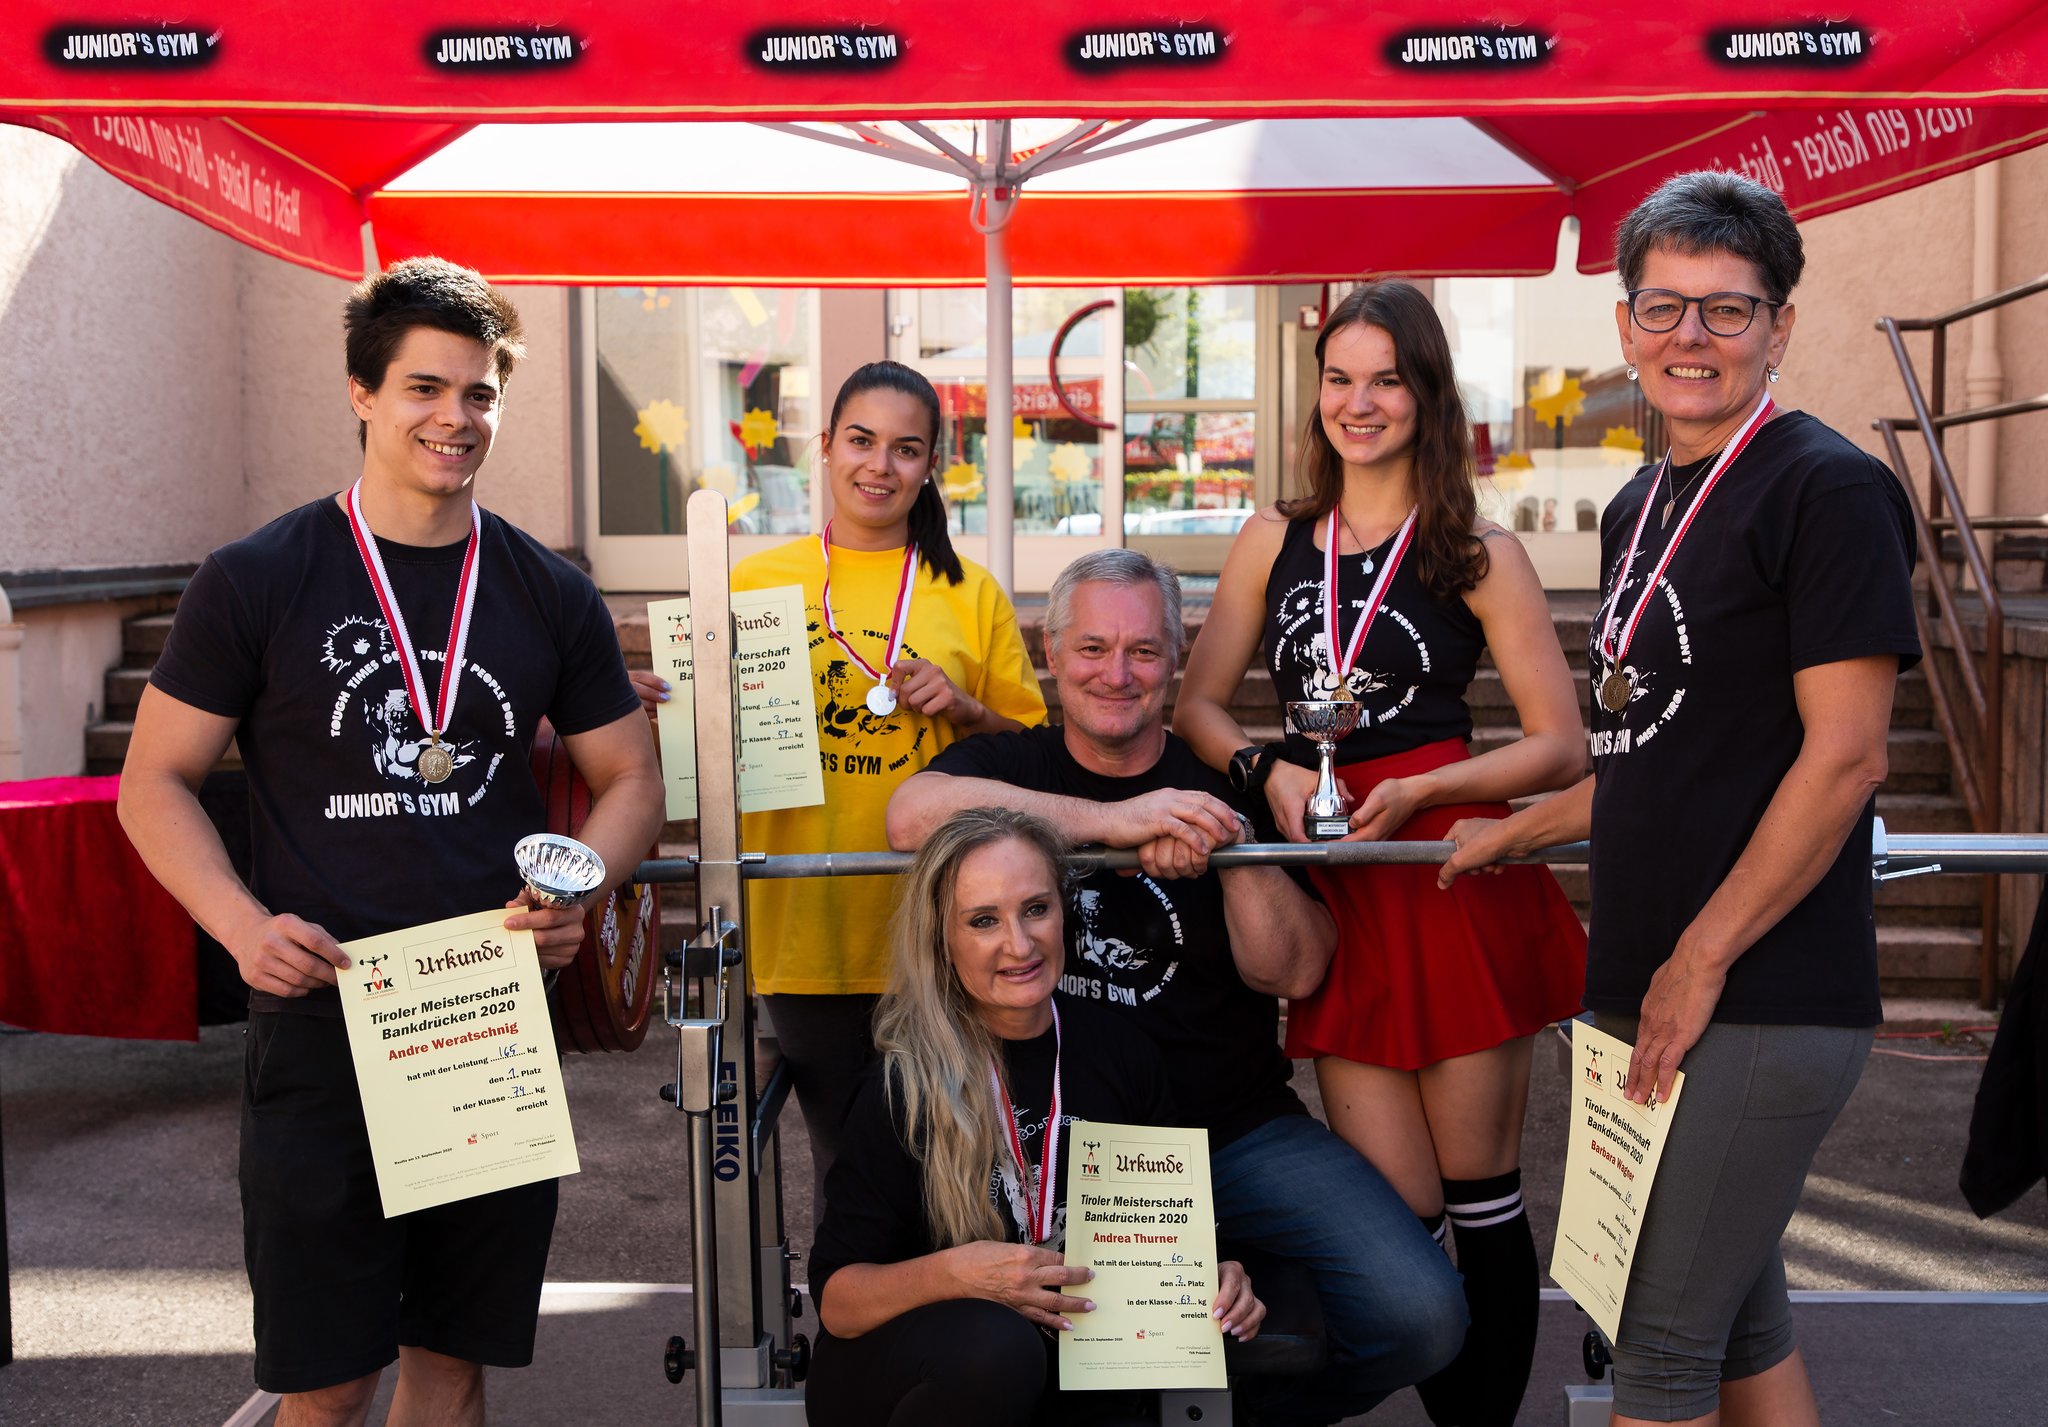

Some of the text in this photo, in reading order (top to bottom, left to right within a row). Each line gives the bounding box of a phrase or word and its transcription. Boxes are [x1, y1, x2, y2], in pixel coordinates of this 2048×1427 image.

[63, 32, 198, 60] JUNIOR'S GYM
[436, 35, 528, 63] JUNIOR'S
[530, 35, 572, 60] GYM
[762, 34, 853, 62] JUNIOR'S
[855, 34, 897, 59] GYM
[1080, 31, 1172, 59] JUNIOR'S
[1173, 31, 1216, 56] GYM
[1402, 35, 1493, 63] JUNIOR'S
[1495, 35, 1537, 60] GYM
[1726, 31, 1818, 59] JUNIOR'S
[1819, 31, 1862, 56] GYM
[736, 611, 781, 632] kunde
[1664, 584, 1692, 665] PEOPLE DON'T
[669, 633, 691, 643] TVK
[808, 636, 825, 651] MES
[862, 629, 890, 641] TOUG
[900, 643, 922, 659] PEO
[1274, 600, 1432, 673] TOUGH TIMES TOH PEOPLE DON'T
[672, 646, 791, 668] Tiro terschaft
[757, 661, 786, 673] 2020
[330, 690, 351, 738] TOUGH
[346, 659, 380, 690] TIMES
[420, 649, 468, 668] TOU
[469, 663, 506, 700] PEOPLE
[501, 701, 515, 738] DON'T
[742, 681, 764, 691] Sari
[740, 703, 761, 711] istung
[768, 697, 781, 707] 60
[1377, 706, 1400, 724] IMST
[759, 719, 771, 727] den
[784, 716, 802, 724] Platz
[1636, 687, 1686, 748] IMST TIROL
[749, 735, 771, 743] Klasse
[794, 731, 803, 739] kg
[778, 742, 804, 751] erreicht
[888, 726, 928, 771] IMST TIROL
[845, 755, 882, 775] GYM
[467, 752, 505, 807] IMST TIROL
[324, 791, 460, 820] JUNIOR'S GYM
[1143, 877, 1184, 945] PEOPLE DON'T
[414, 939, 505, 977] Urkunde
[363, 977, 394, 993] TVK
[1058, 973, 1138, 1007] IOR'S GYM
[1142, 984, 1162, 1002] IMST
[370, 1005, 418, 1025] Tiroler
[420, 981, 521, 1014] Meisterschaft
[381, 999, 516, 1041] Bankdrücken 2020
[387, 1021, 519, 1061] Andre Weratschnig
[406, 1042, 538, 1082] hat mit der Leistung 165 kg
[488, 1075, 505, 1085] den
[520, 1067, 542, 1077] Platz
[1585, 1067, 1603, 1084] TVK
[452, 1105, 462, 1113] in
[462, 1101, 477, 1111] der
[477, 1095, 506, 1107] Klasse
[534, 1085, 546, 1095] kg
[516, 1100, 549, 1113] erreicht
[714, 1062, 740, 1182] EEIKO
[1019, 1124, 1036, 1141] GO
[1584, 1097, 1651, 1151] Tiroler Meisterschaft
[480, 1130, 500, 1140] Sport
[1587, 1115, 1644, 1165] Bankdrücken 2020
[1082, 1163, 1100, 1175] TVK
[1115, 1153, 1184, 1174] Urkunde
[1590, 1139, 1635, 1183] Barbara Wagner
[1595, 1173, 1603, 1181] mit
[989, 1167, 1003, 1211] OUGH
[1081, 1194, 1194, 1209] Tiroler Meisterschaft
[1084, 1210, 1188, 1224] Bankdrücken 2020
[1093, 1232, 1178, 1244] Andrea Thurner
[1093, 1259, 1105, 1267] hat
[1131, 1259, 1162, 1268] Leistung
[1171, 1253, 1184, 1264] 60
[1193, 1260, 1203, 1268] kg
[1149, 1298, 1173, 1306] Klasse
[1197, 1299, 1207, 1307] kg
[1180, 1311, 1208, 1319] erreicht
[1148, 1329, 1165, 1338] Sport
